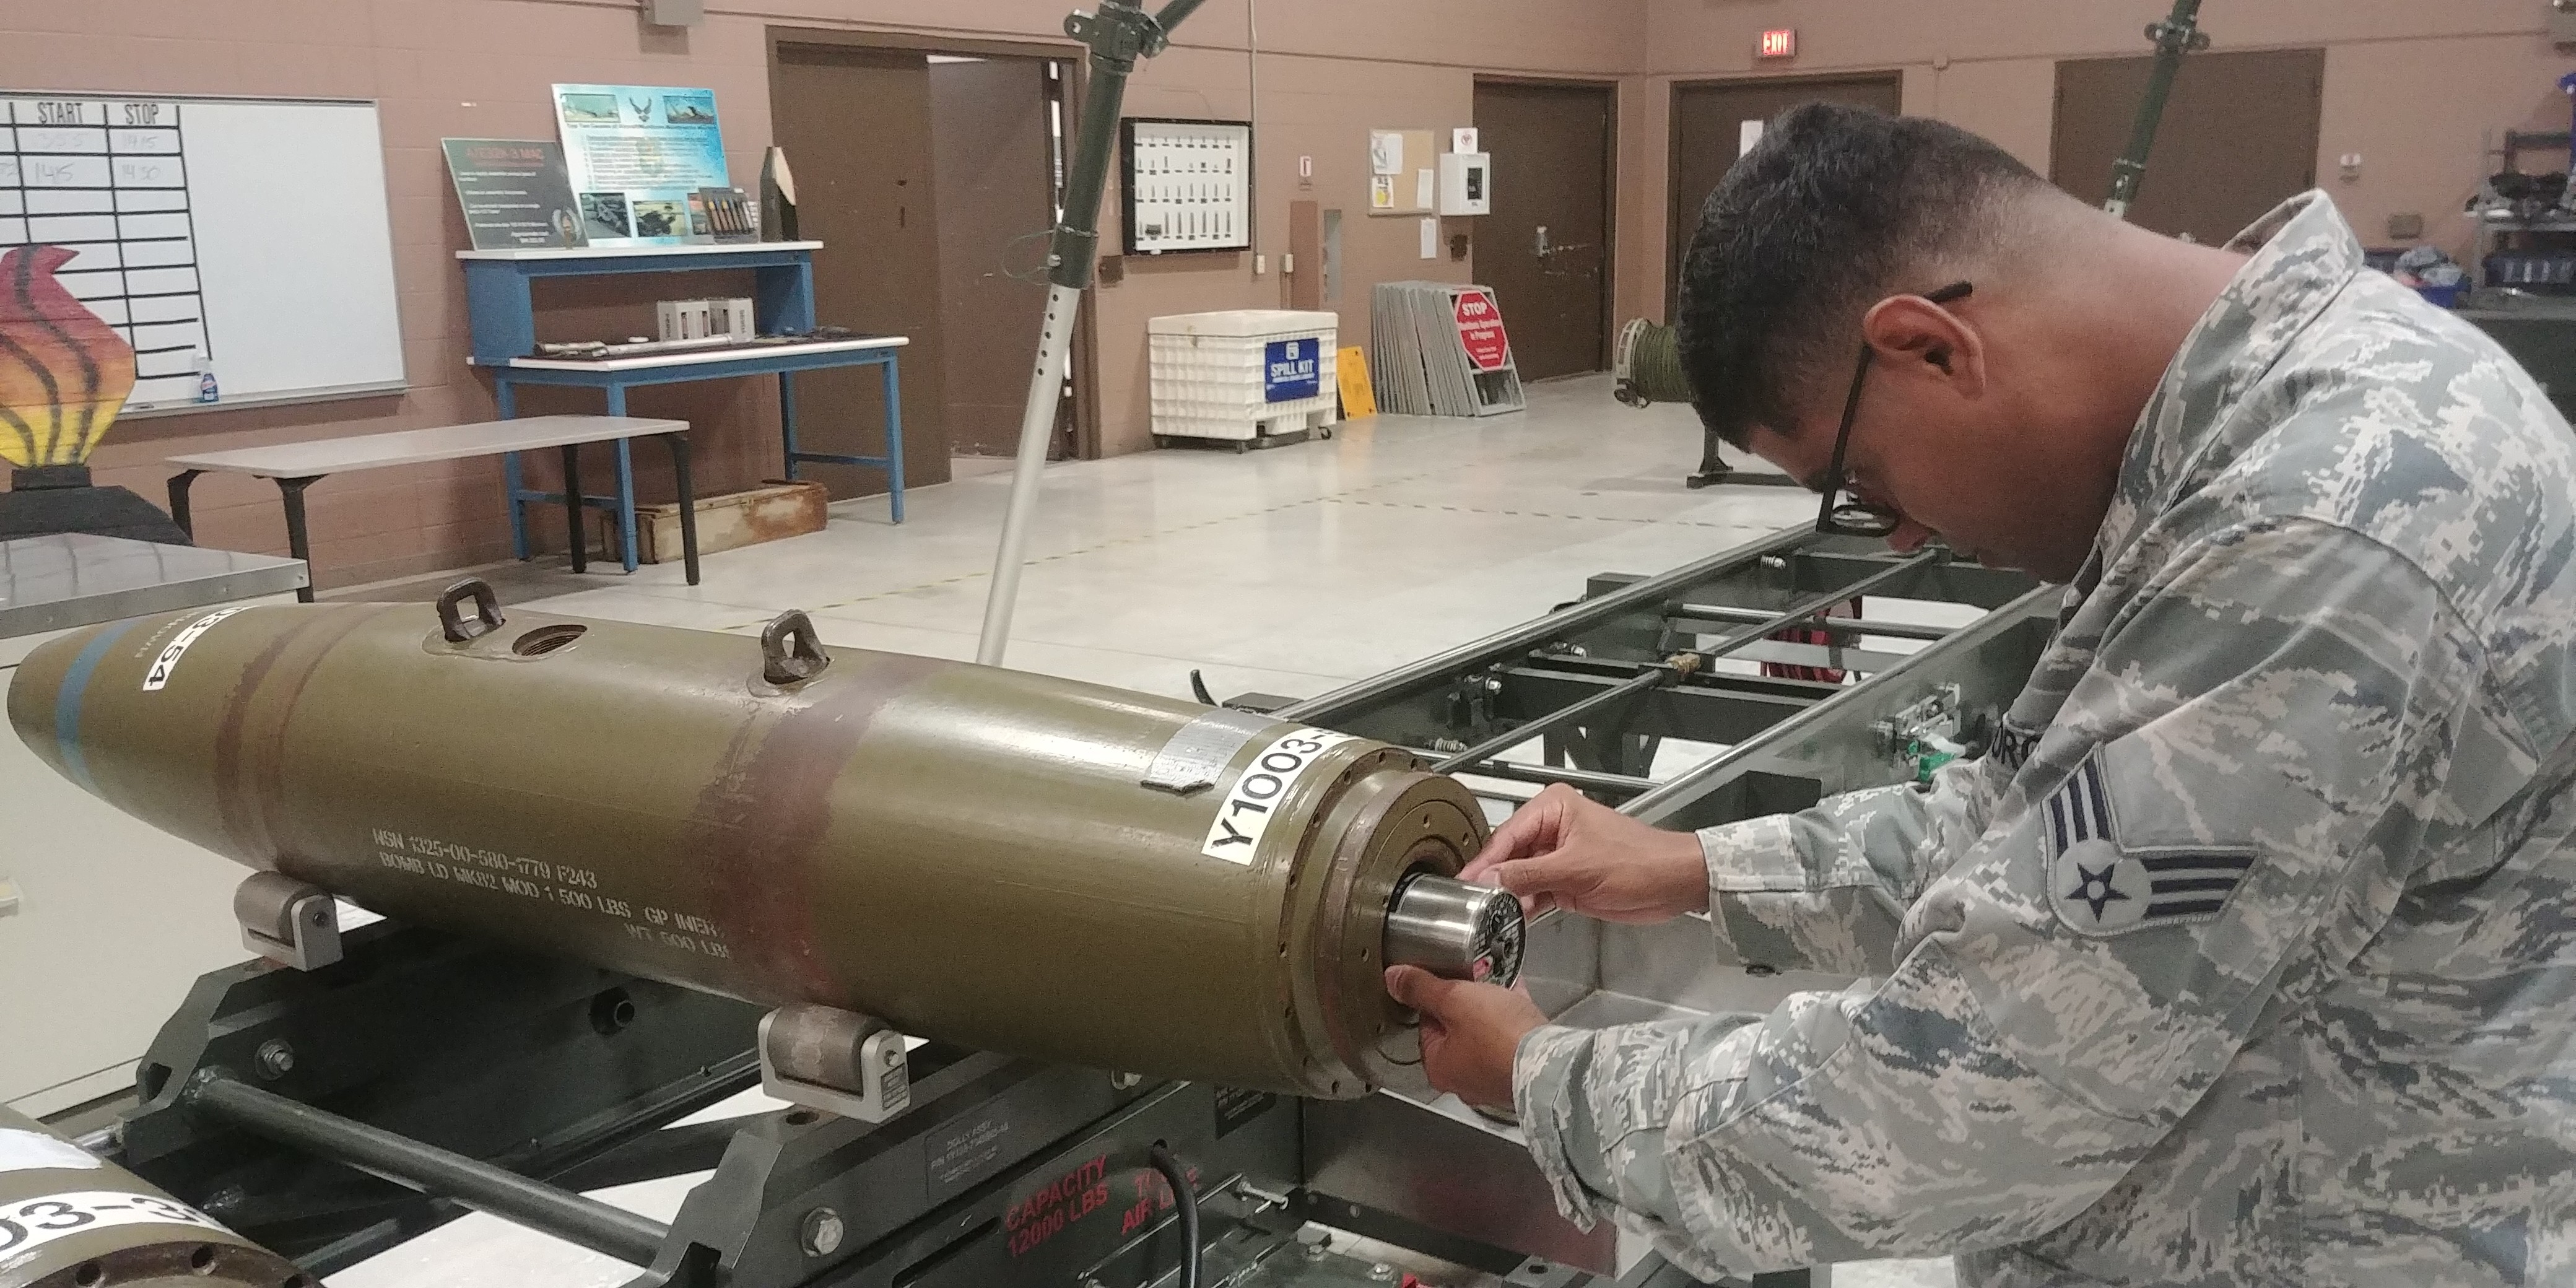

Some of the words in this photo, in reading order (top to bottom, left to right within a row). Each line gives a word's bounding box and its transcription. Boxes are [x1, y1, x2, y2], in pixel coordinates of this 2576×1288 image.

[1763, 32, 1788, 54] EXIT
[37, 102, 83, 123] START
[125, 103, 159, 124] STOP
[1462, 302, 1487, 316] STOP
[1270, 361, 1297, 378] SPILL
[1298, 359, 1313, 373] KIT
[372, 827, 404, 850] NSN
[557, 865, 597, 889] F243
[379, 851, 425, 874] BOMB
[427, 861, 449, 880] LD
[501, 876, 539, 899] MOD
[543, 886, 554, 901] 1
[559, 889, 592, 910] 500
[597, 896, 631, 919] LBS
[645, 907, 668, 925] GP
[1004, 1153, 1107, 1231] CAPACITY
[1069, 1182, 1108, 1222] LBS
[1121, 1197, 1153, 1236] AIR
